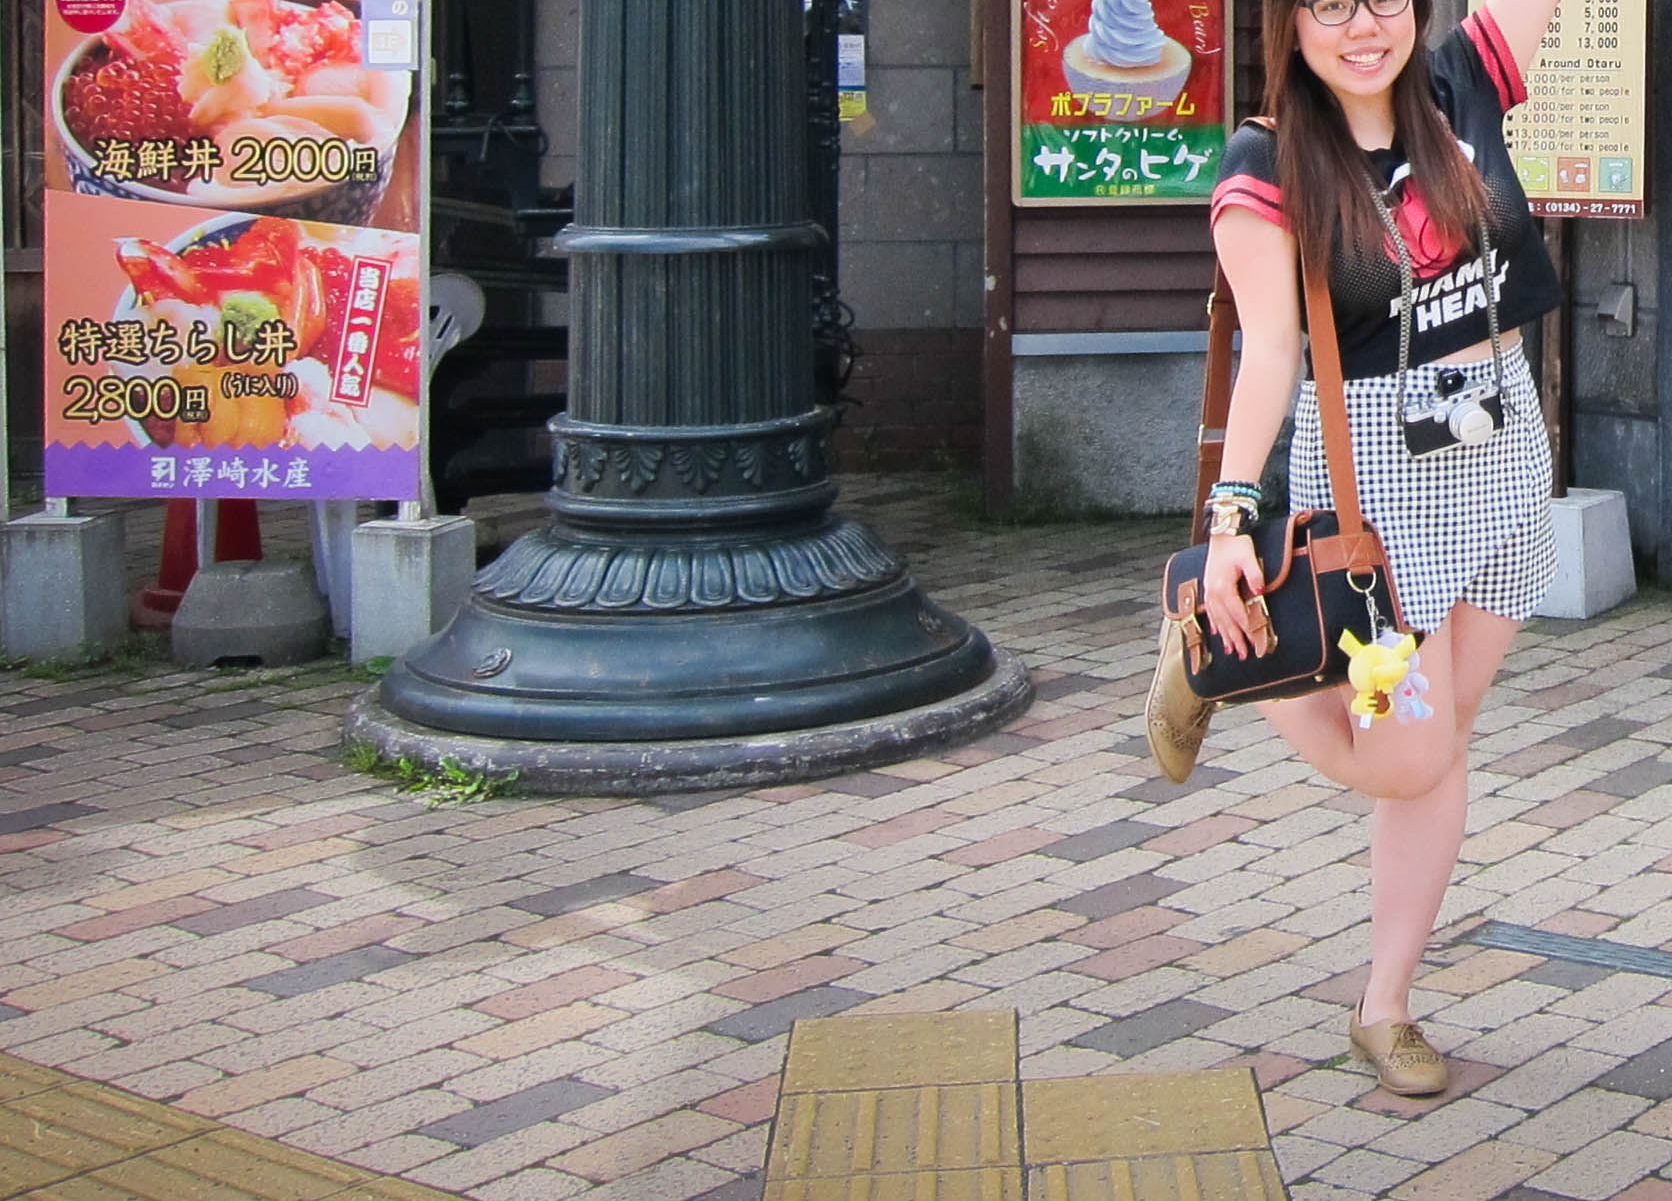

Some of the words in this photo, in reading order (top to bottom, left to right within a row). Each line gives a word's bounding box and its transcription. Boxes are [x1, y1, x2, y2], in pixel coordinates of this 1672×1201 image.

[1585, 7, 1618, 19] 5,000
[1585, 22, 1618, 34] 7,000
[1578, 37, 1618, 49] 13,000
[1540, 58, 1581, 68] Around
[1587, 58, 1622, 69] Otaru
[1580, 75, 1610, 84] person
[1599, 87, 1631, 96] people
[1580, 103, 1610, 112] person
[1599, 115, 1630, 124] people
[1063, 127, 1183, 143] ソフトクリーム
[1579, 129, 1610, 139] person
[1599, 143, 1630, 152] people
[93, 138, 223, 183] 海鮮丼
[230, 136, 377, 186] 2,000円
[1033, 144, 1213, 184] サンタのヒゲ
[339, 266, 381, 397] 当店一番人気
[58, 320, 297, 365] 特選ちらし丼
[221, 372, 299, 398] (うに入り)
[63, 376, 208, 423] 2,800円
[183, 456, 312, 489] 澤崎水産
